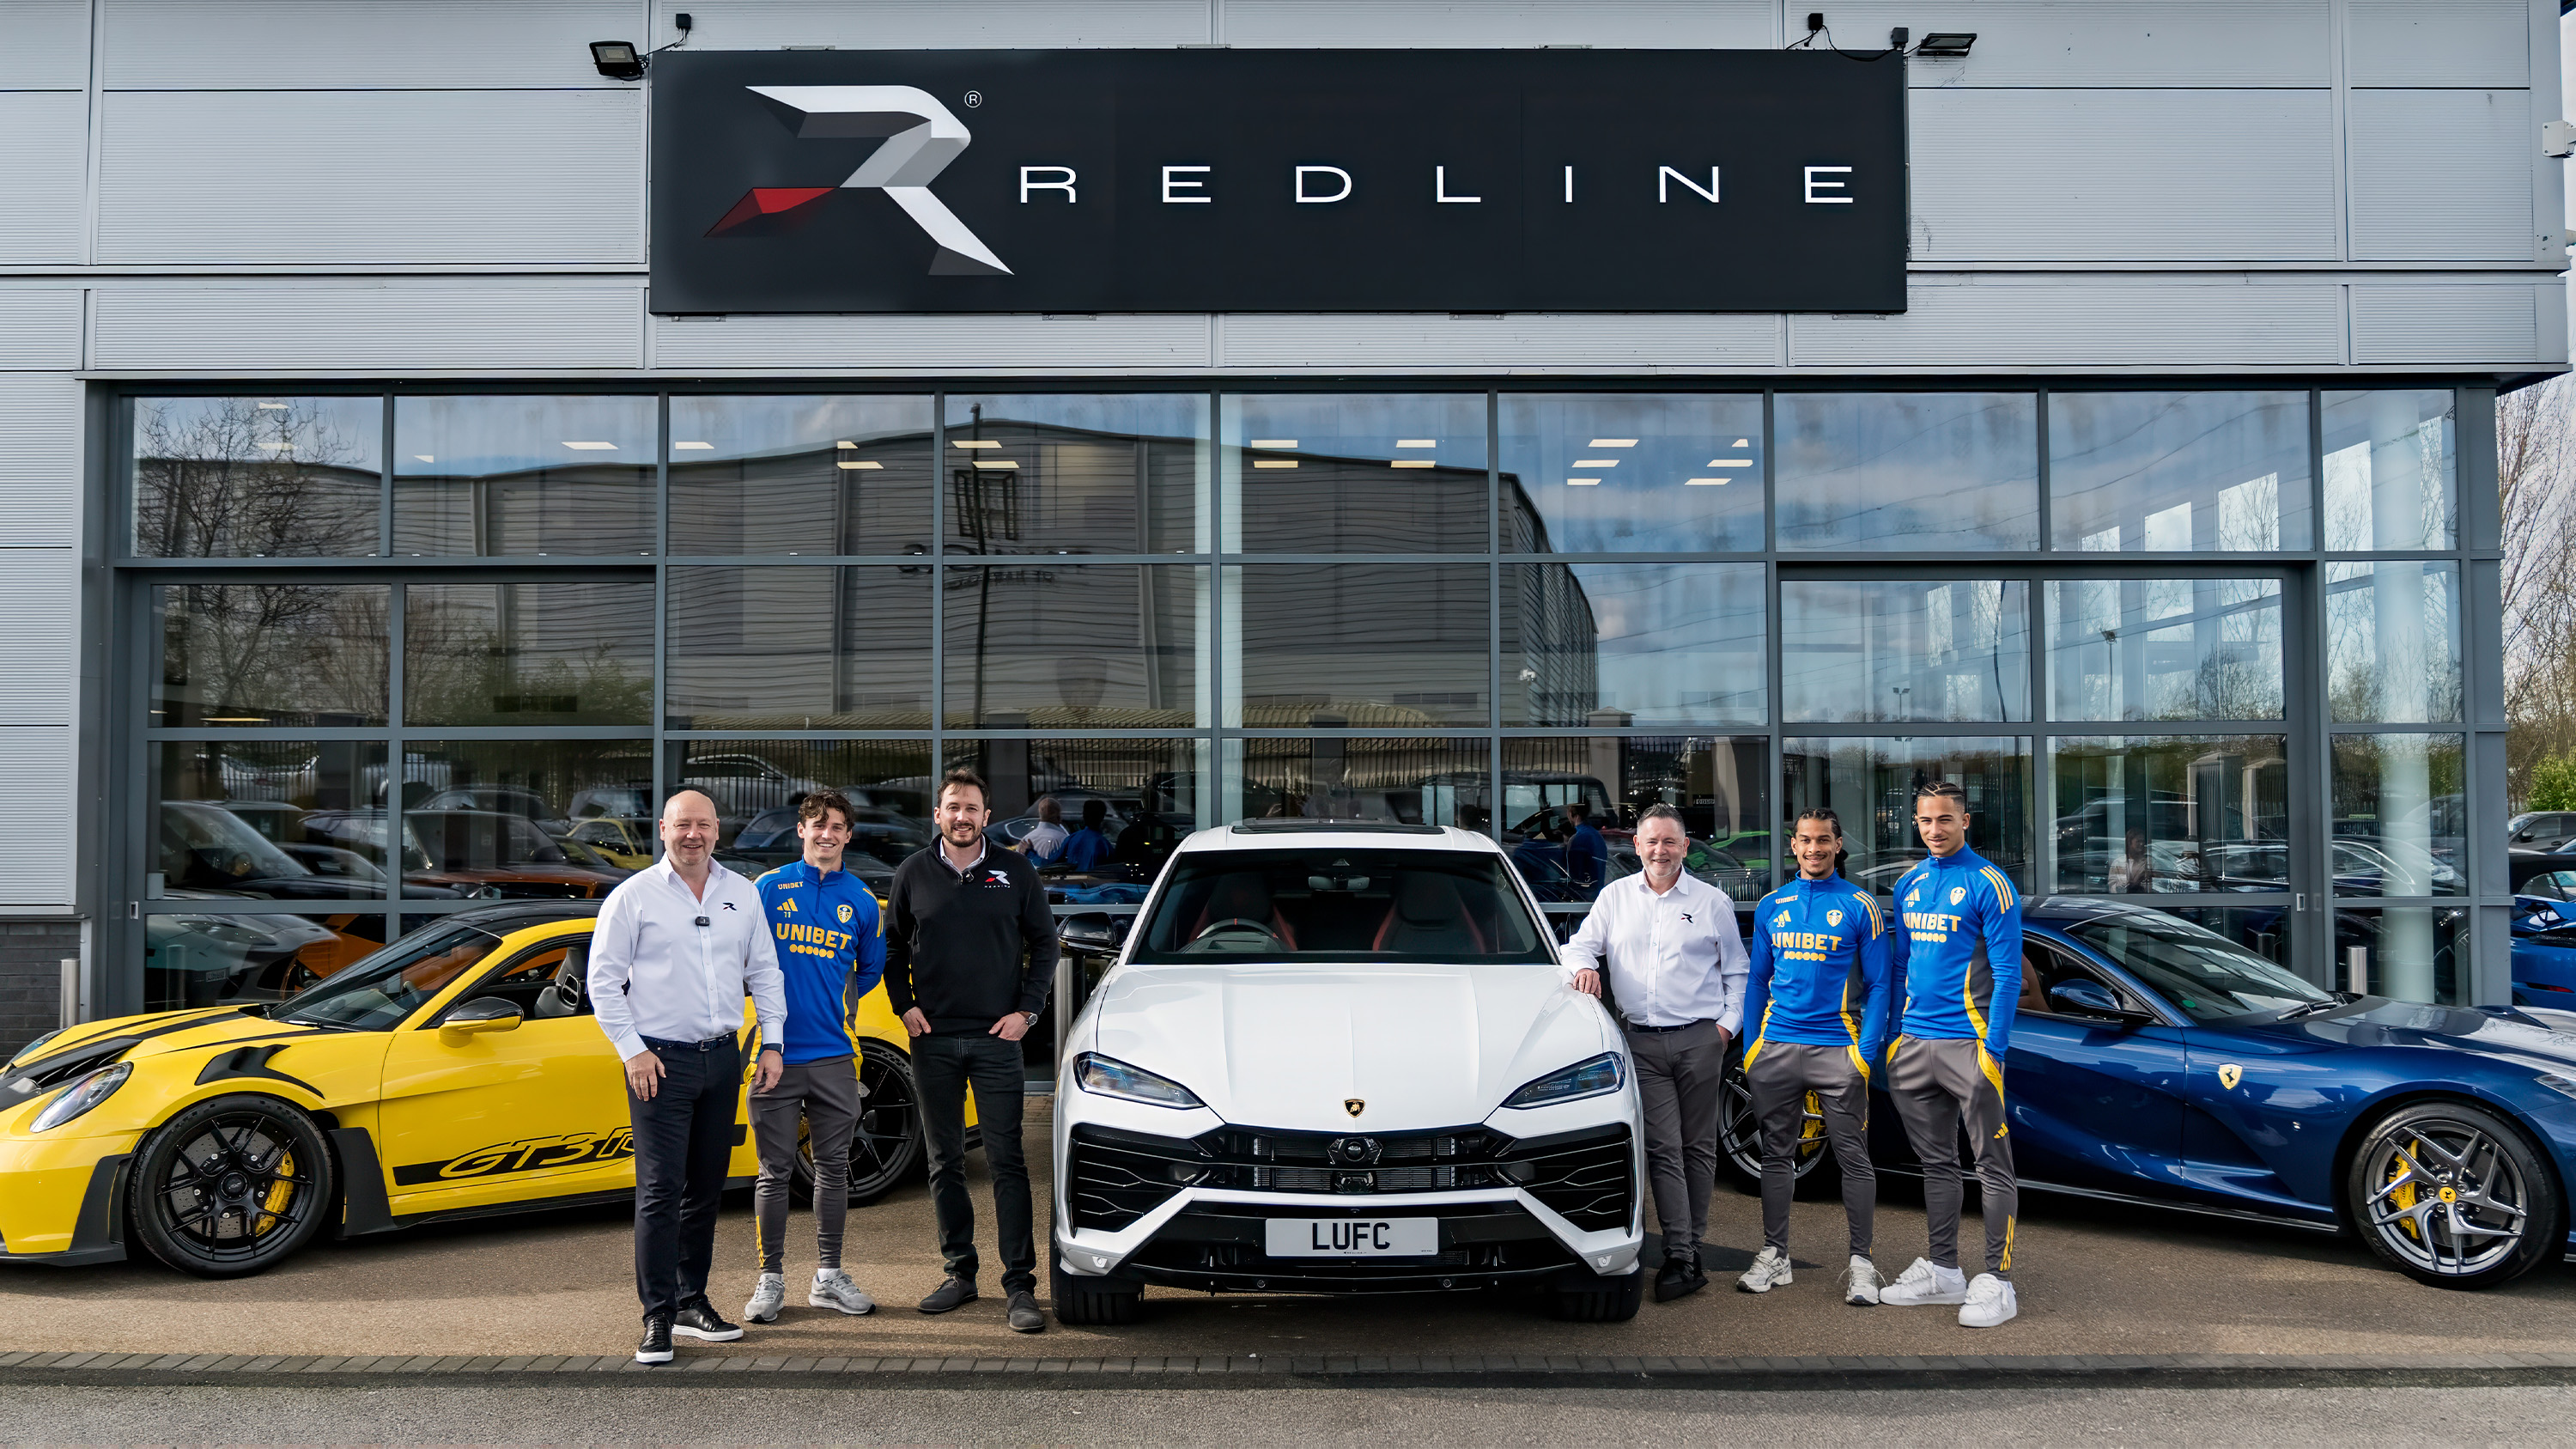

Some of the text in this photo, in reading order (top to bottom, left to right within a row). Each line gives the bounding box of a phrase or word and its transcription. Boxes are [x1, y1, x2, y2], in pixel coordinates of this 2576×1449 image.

[1020, 166, 1853, 204] REDLINE
[778, 881, 804, 890] UNIBET
[1902, 912, 1962, 932] UNIBET
[776, 922, 853, 950] UNIBET
[1771, 932, 1843, 952] UNIBET
[1312, 1222, 1391, 1251] LUFC
